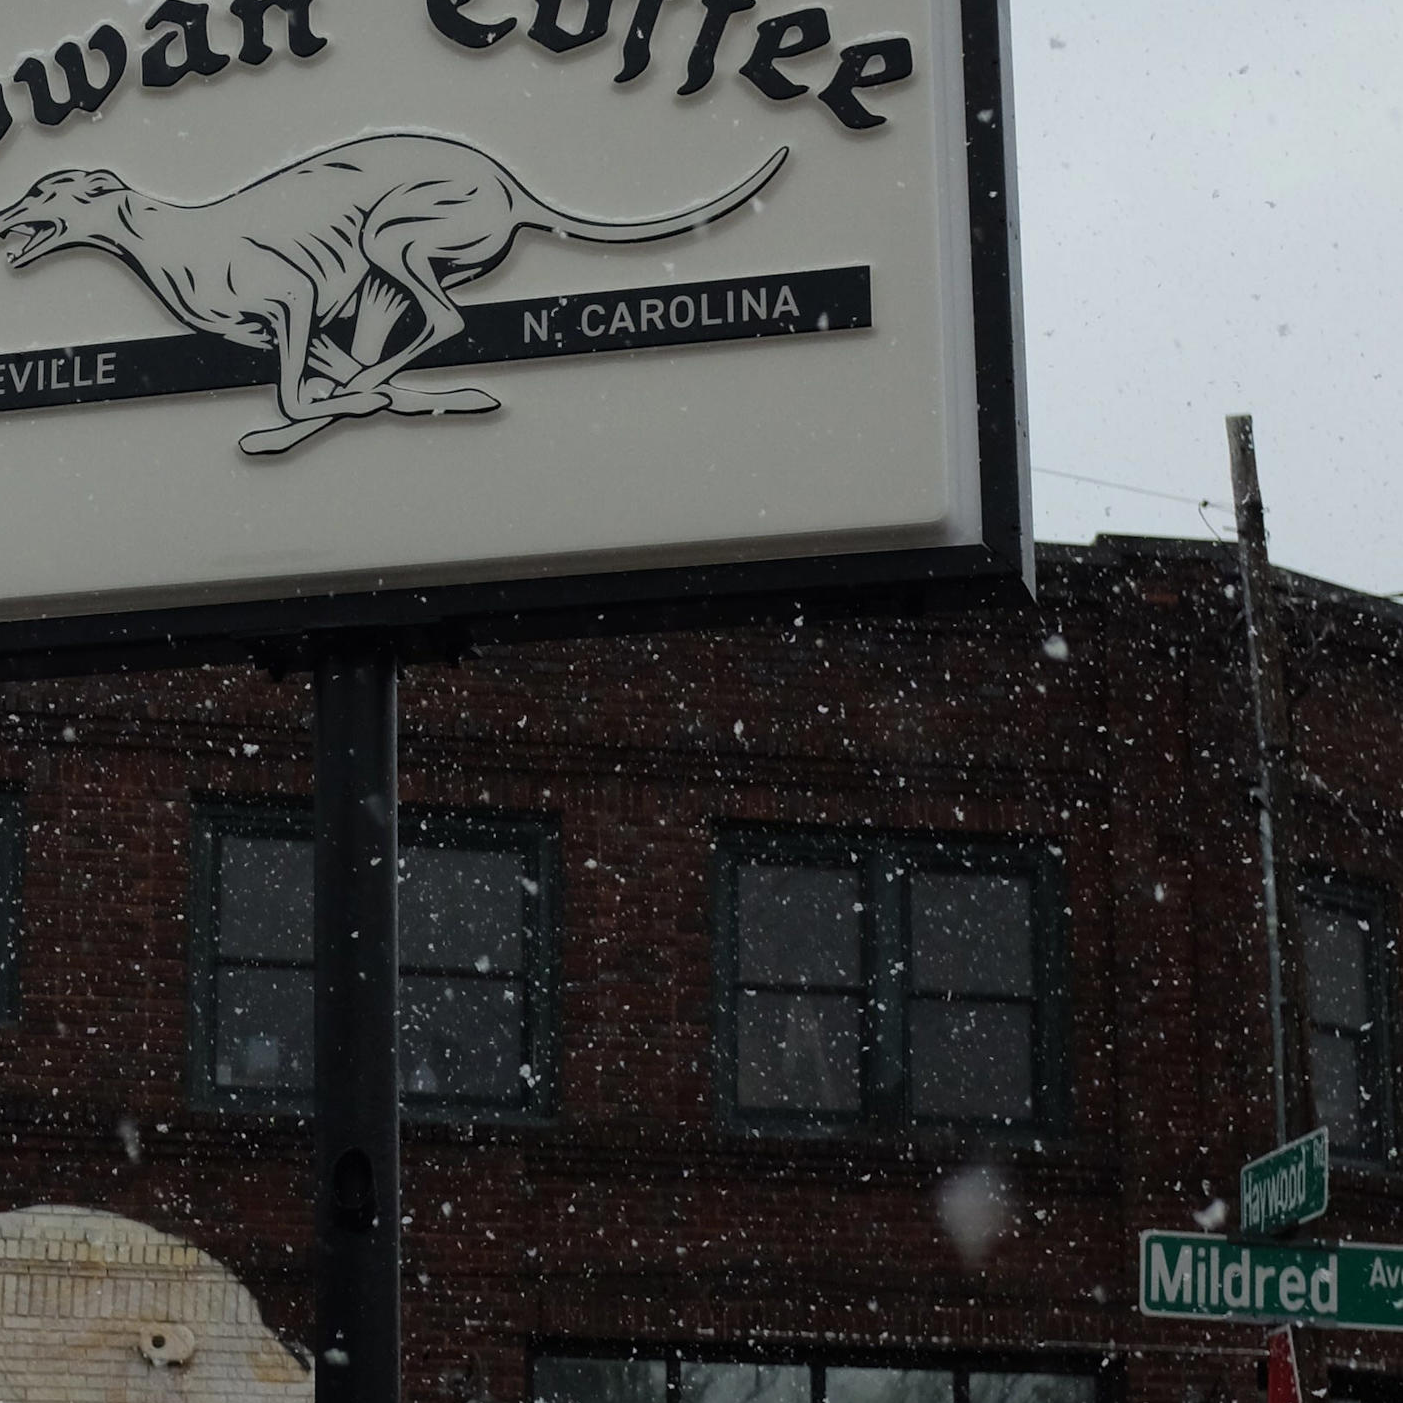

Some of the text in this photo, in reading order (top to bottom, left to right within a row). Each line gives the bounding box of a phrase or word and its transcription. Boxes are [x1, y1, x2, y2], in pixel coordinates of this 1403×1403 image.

[581, 285, 800, 338] CAROLINA
[1242, 1134, 1325, 1233] Haywood Rd
[1151, 1243, 1339, 1313] Mildred
